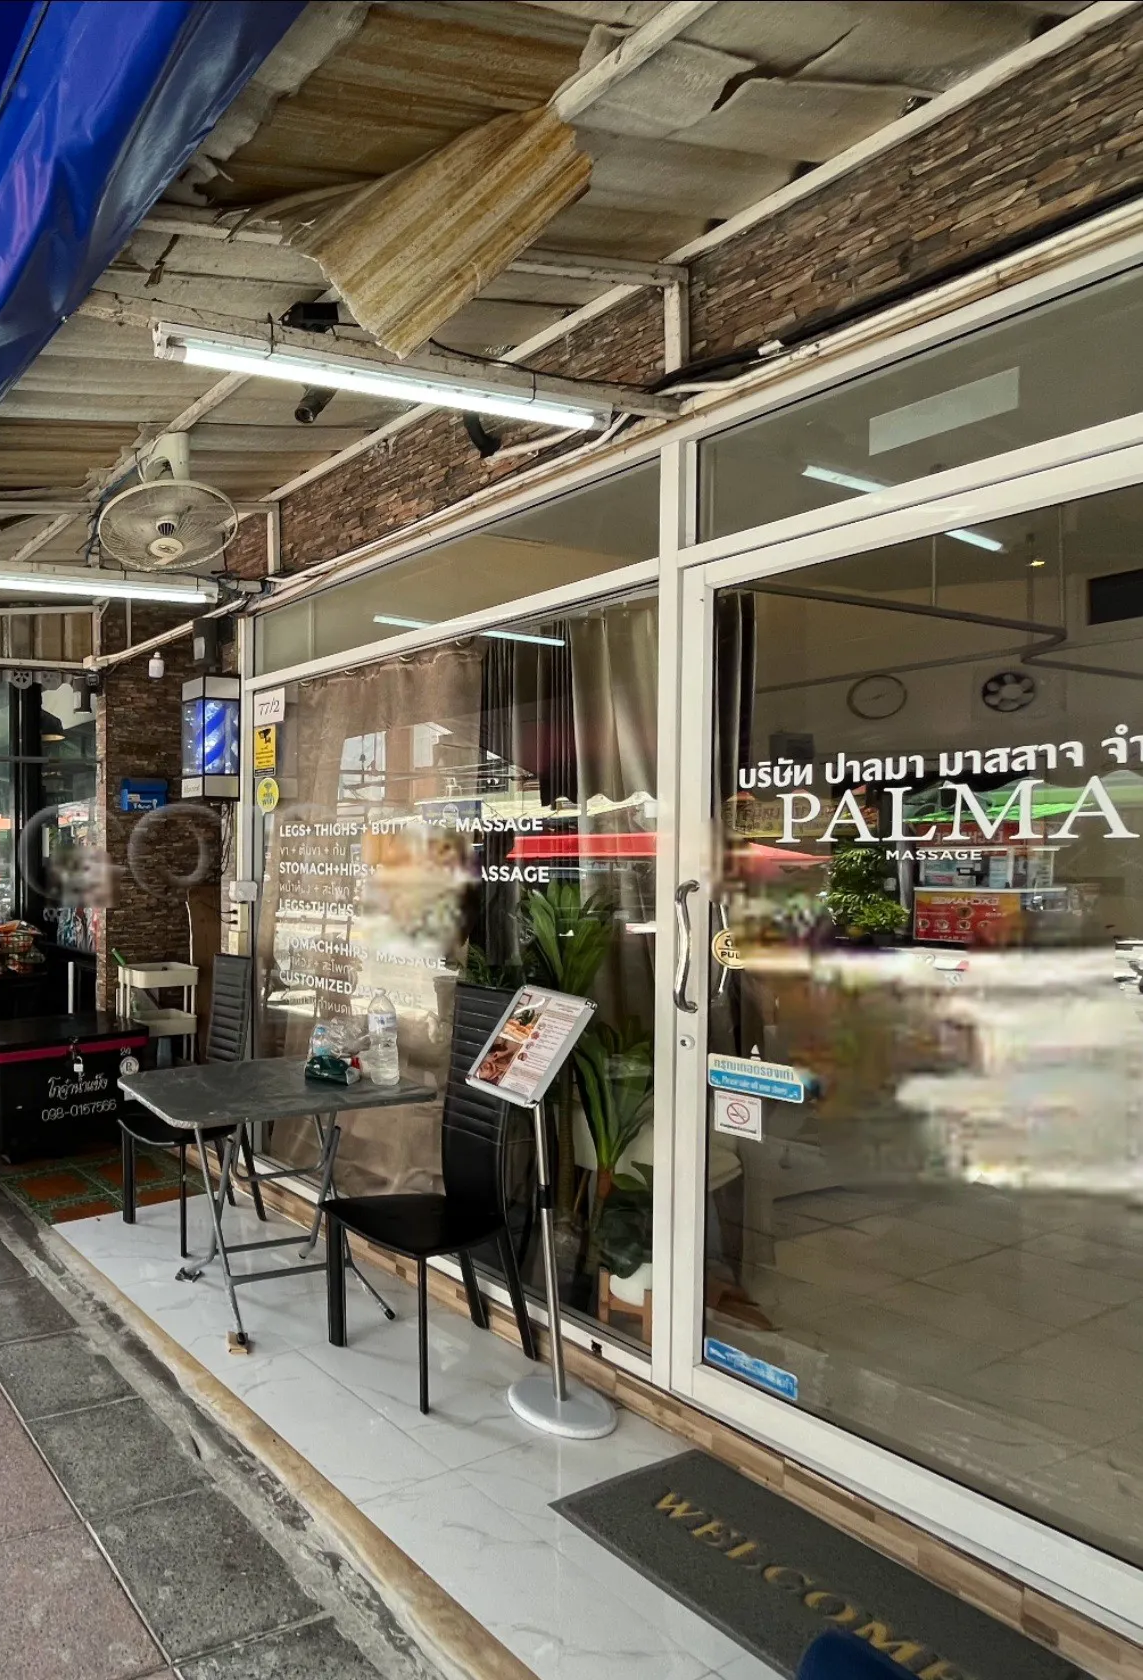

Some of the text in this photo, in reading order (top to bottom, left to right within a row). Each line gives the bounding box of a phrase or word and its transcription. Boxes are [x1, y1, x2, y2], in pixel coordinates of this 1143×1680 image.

[258, 697, 280, 716] 77/2
[738, 756, 813, 790] บริษัท
[825, 752, 924, 786] ปาลมา
[939, 740, 1085, 777] มาสสาจ
[775, 774, 1141, 845] PALMA
[314, 822, 358, 837] THIGHS
[455, 817, 544, 833] MASSAGE
[886, 849, 983, 862] MASSAGE
[481, 865, 551, 883] ASSAGE
[279, 970, 353, 996] CUSTOMIZED
